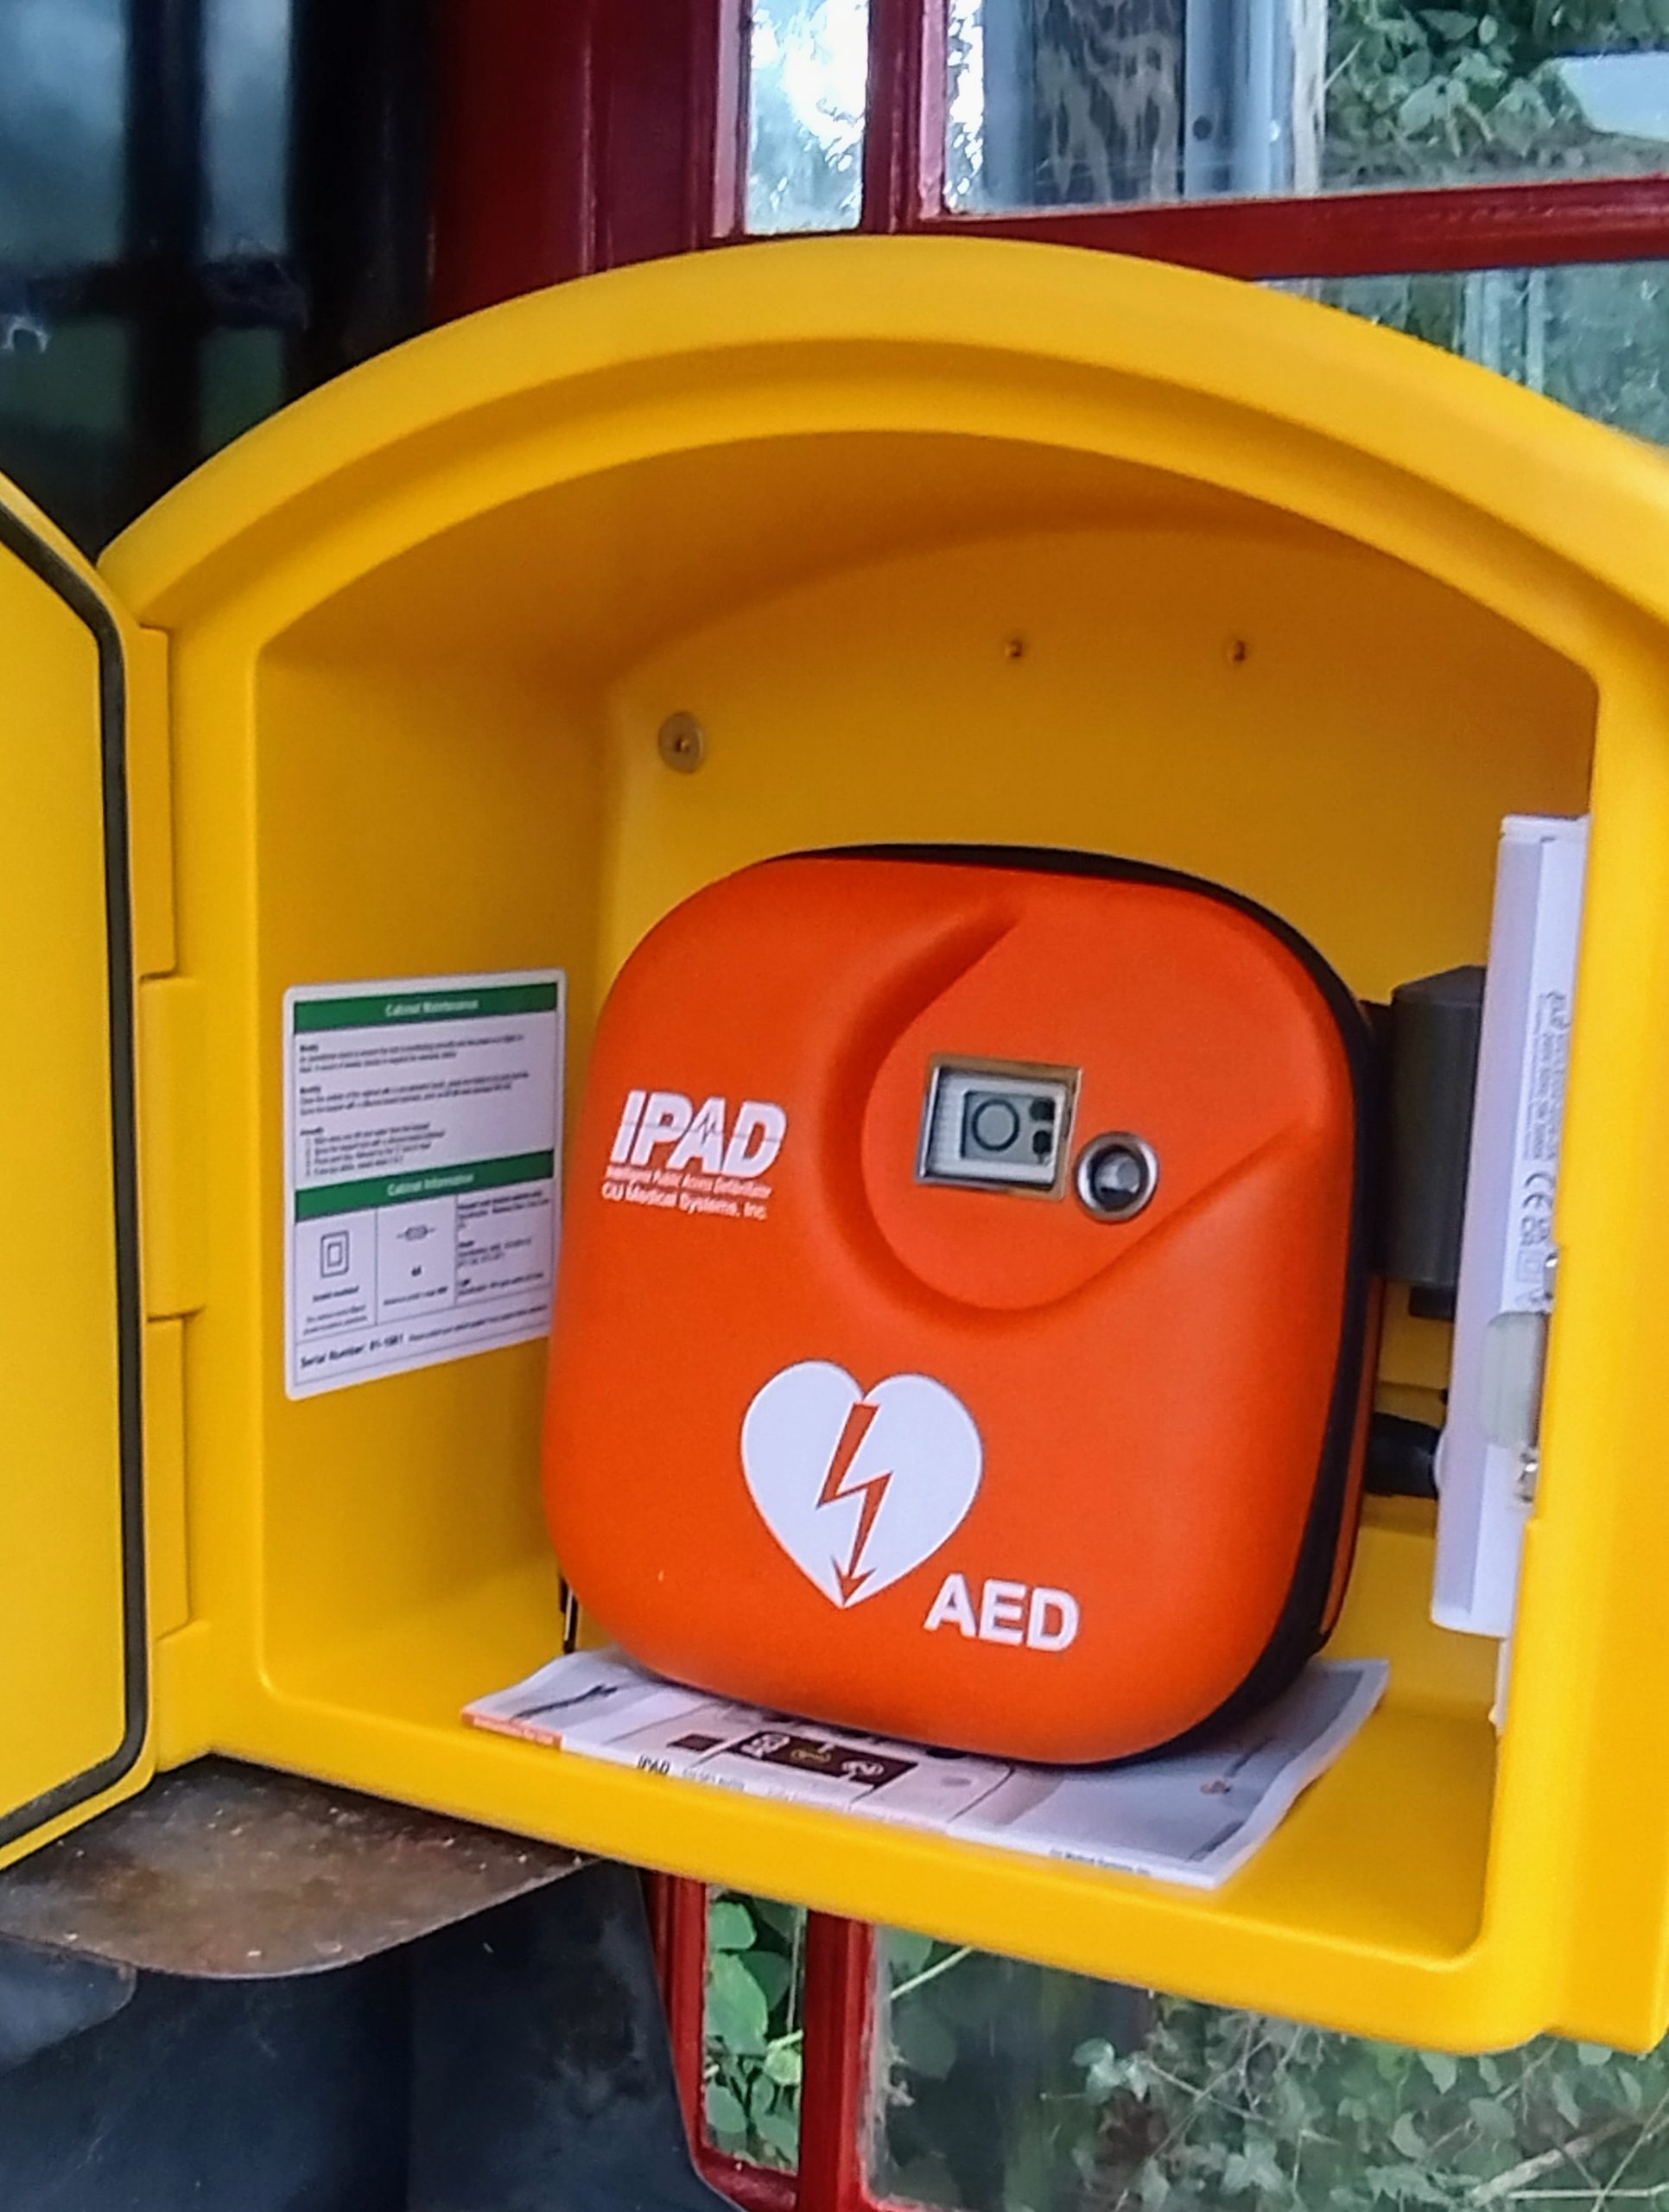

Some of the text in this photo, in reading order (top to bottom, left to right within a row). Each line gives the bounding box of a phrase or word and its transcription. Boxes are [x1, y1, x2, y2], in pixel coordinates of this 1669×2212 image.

[610, 1089, 788, 1179] IPAD
[601, 1182, 624, 1201] CU
[923, 1573, 1080, 1652] AED
